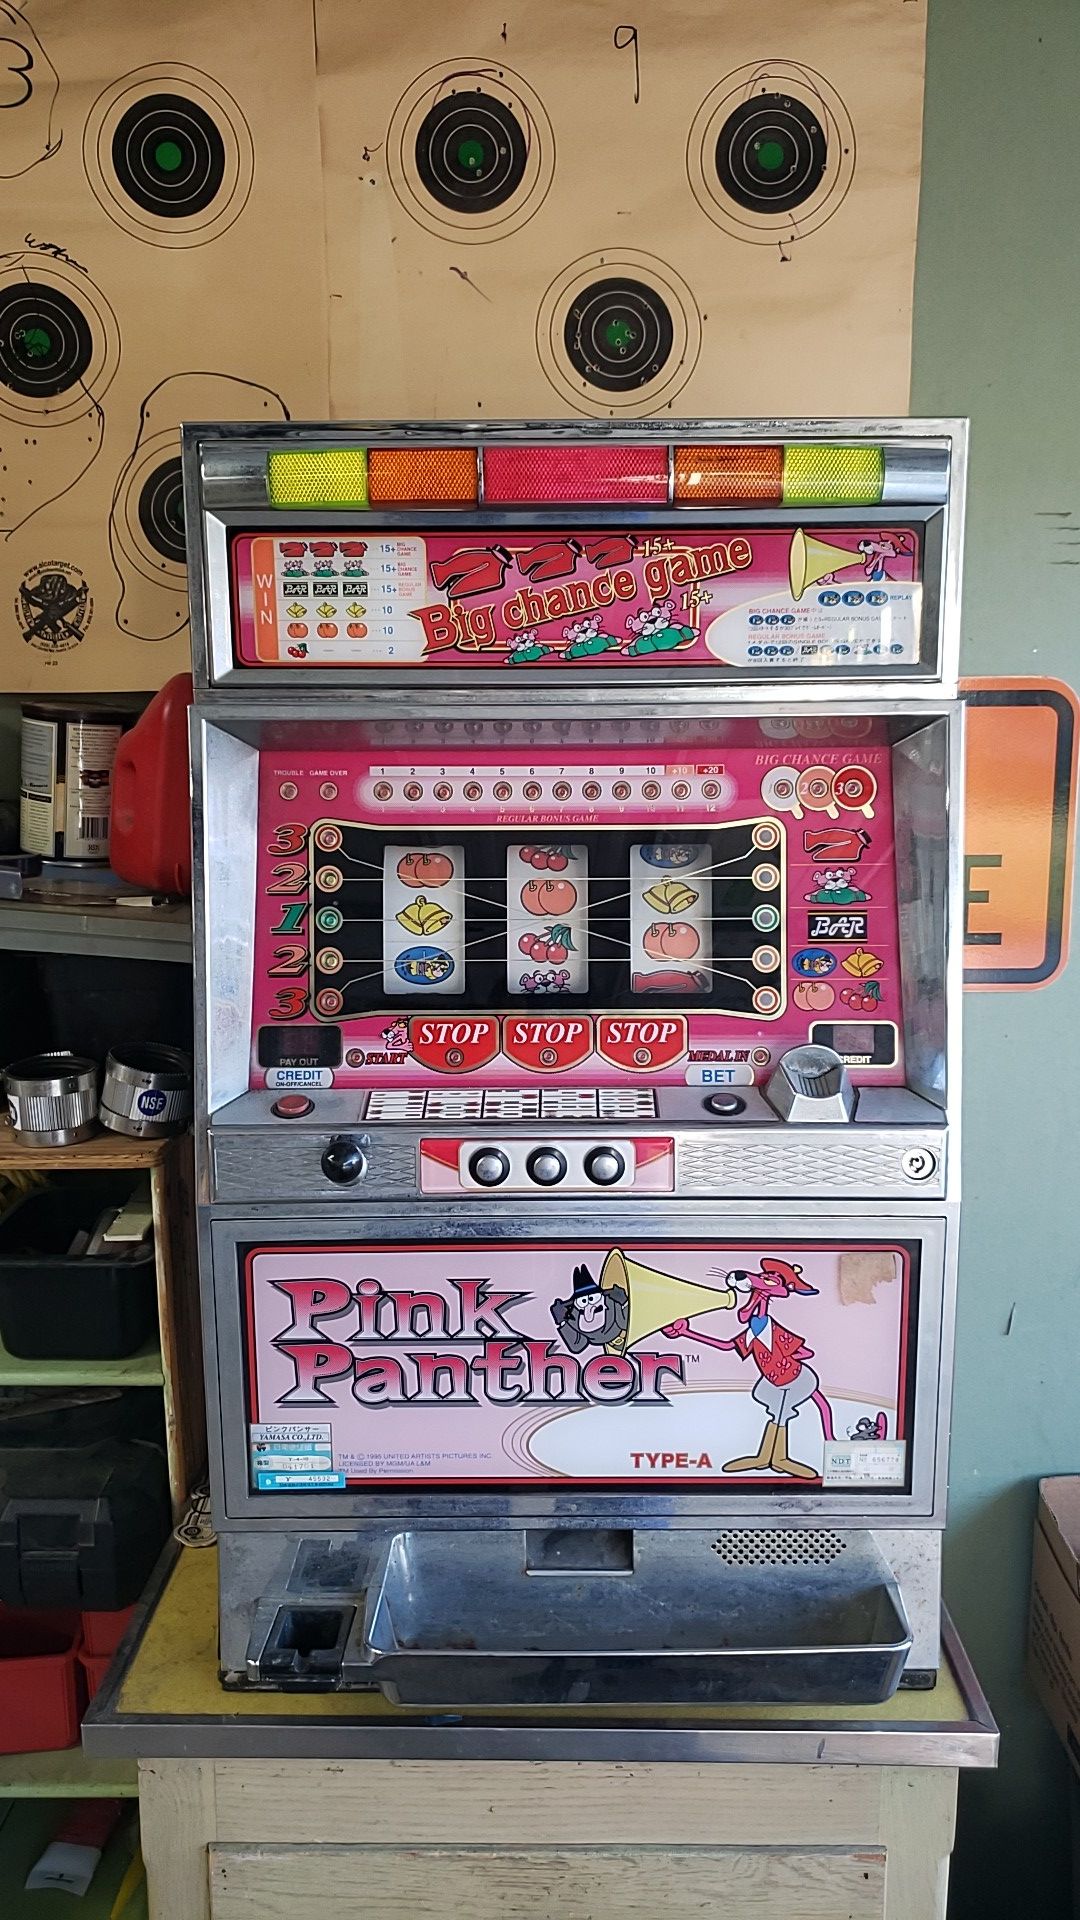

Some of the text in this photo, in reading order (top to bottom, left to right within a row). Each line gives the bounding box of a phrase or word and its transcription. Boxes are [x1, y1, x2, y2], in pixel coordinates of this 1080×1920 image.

[380, 544, 396, 554] 15+
[642, 536, 675, 558] 15+
[381, 564, 397, 573] 15+
[284, 584, 397, 594] BAR BAR BAR 15+
[411, 537, 753, 656] Big chance game
[679, 589, 713, 611] 15+
[382, 606, 393, 614] 10
[383, 626, 394, 635] 10
[388, 647, 394, 655] 2
[755, 753, 882, 765] BIG CHANCE GAME
[380, 766, 719, 775] 1 2 3 4 5 6 7 8 9 10 +10 +20
[706, 804, 716, 812] 12
[496, 814, 599, 823] REGULAR BONUS GAME
[266, 823, 308, 856] 3
[266, 862, 308, 894] 2
[270, 903, 309, 934] 1
[810, 916, 865, 938] BAR
[267, 944, 308, 975] 2
[268, 987, 308, 1018] 3
[419, 1022, 490, 1045] STOP
[513, 1022, 584, 1044] STOP
[606, 1021, 677, 1044] STOP
[280, 1057, 319, 1066] PAY OUT
[365, 1052, 408, 1065] START
[687, 1050, 750, 1062] MEDAL IN
[276, 1070, 322, 1081] CREDIT
[701, 1069, 736, 1083] BET
[269, 1277, 534, 1343] Pink
[270, 1339, 686, 1407] Panther
[260, 1433, 290, 1441] YAMASA
[630, 1452, 713, 1469] TYPE-A
